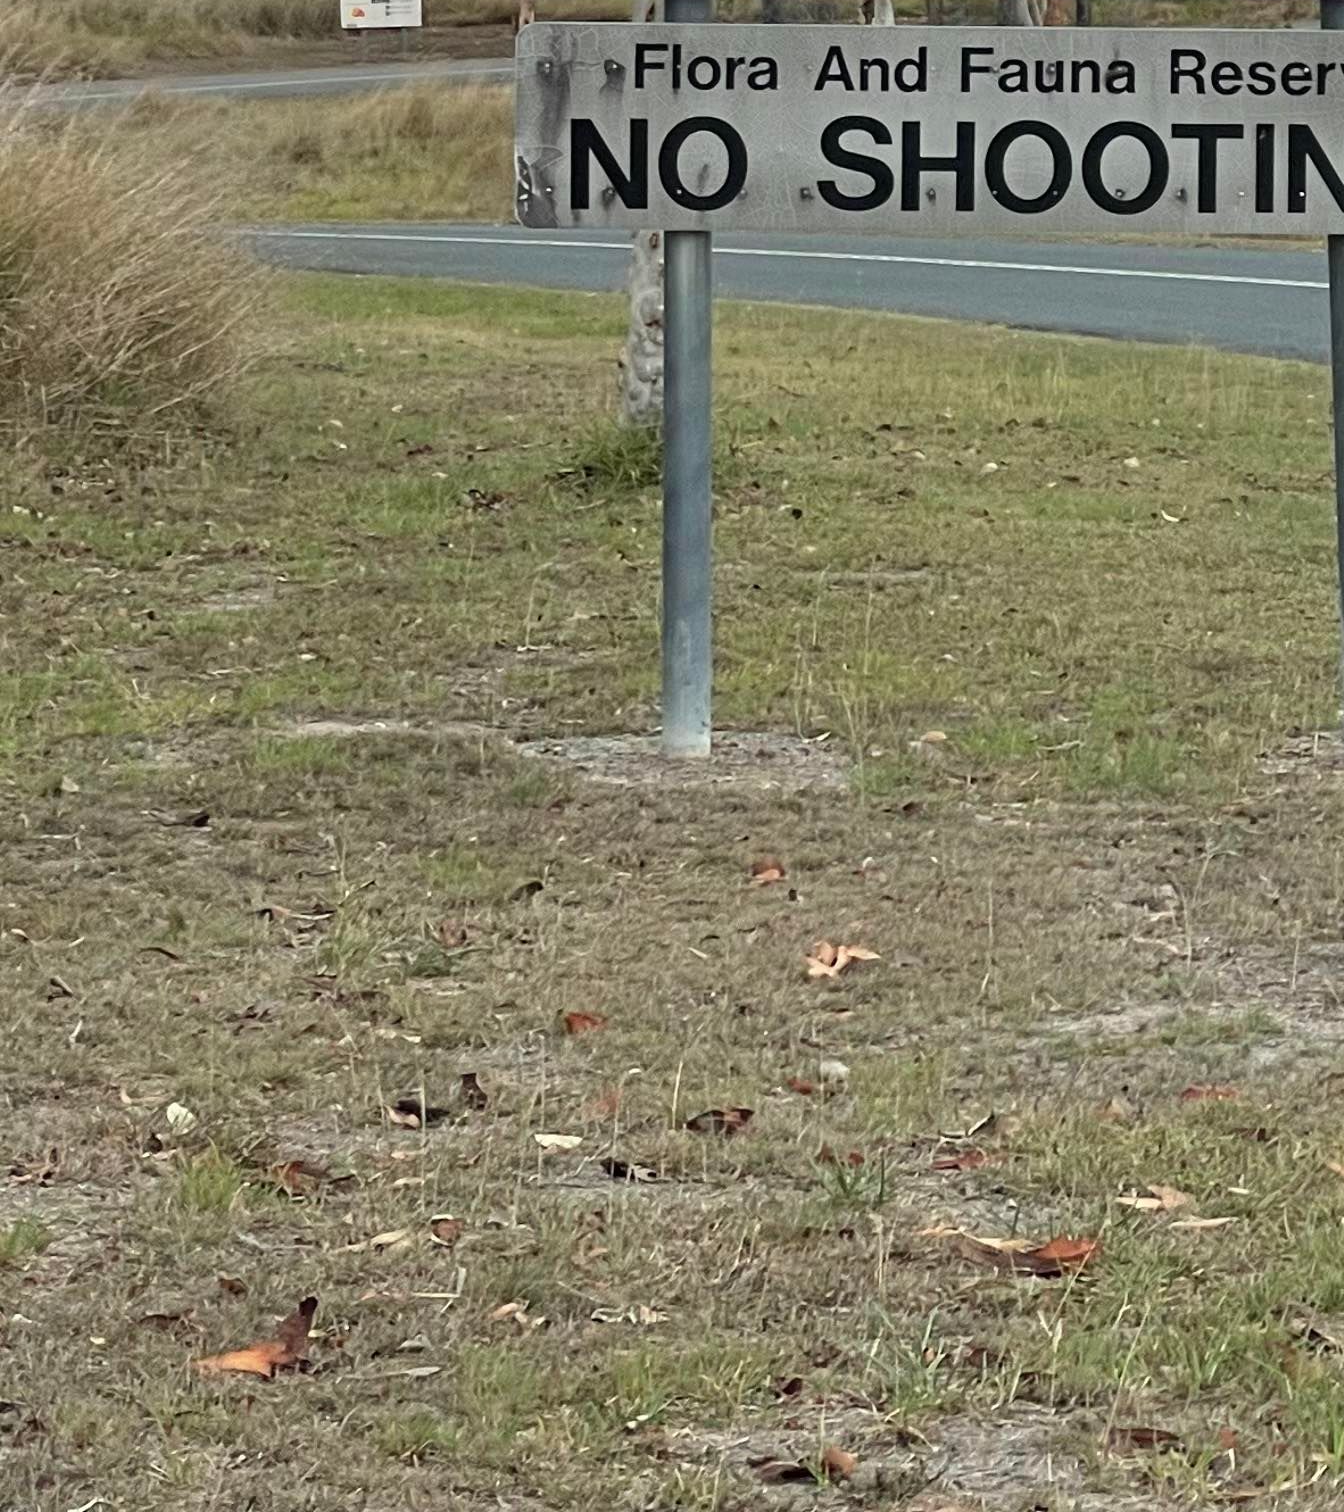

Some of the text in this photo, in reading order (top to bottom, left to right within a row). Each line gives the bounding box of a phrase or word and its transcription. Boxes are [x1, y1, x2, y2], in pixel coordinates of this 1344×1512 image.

[633, 42, 779, 92] Flora
[813, 45, 929, 94] And
[959, 46, 1137, 95] Fauna
[569, 116, 749, 213] NO
